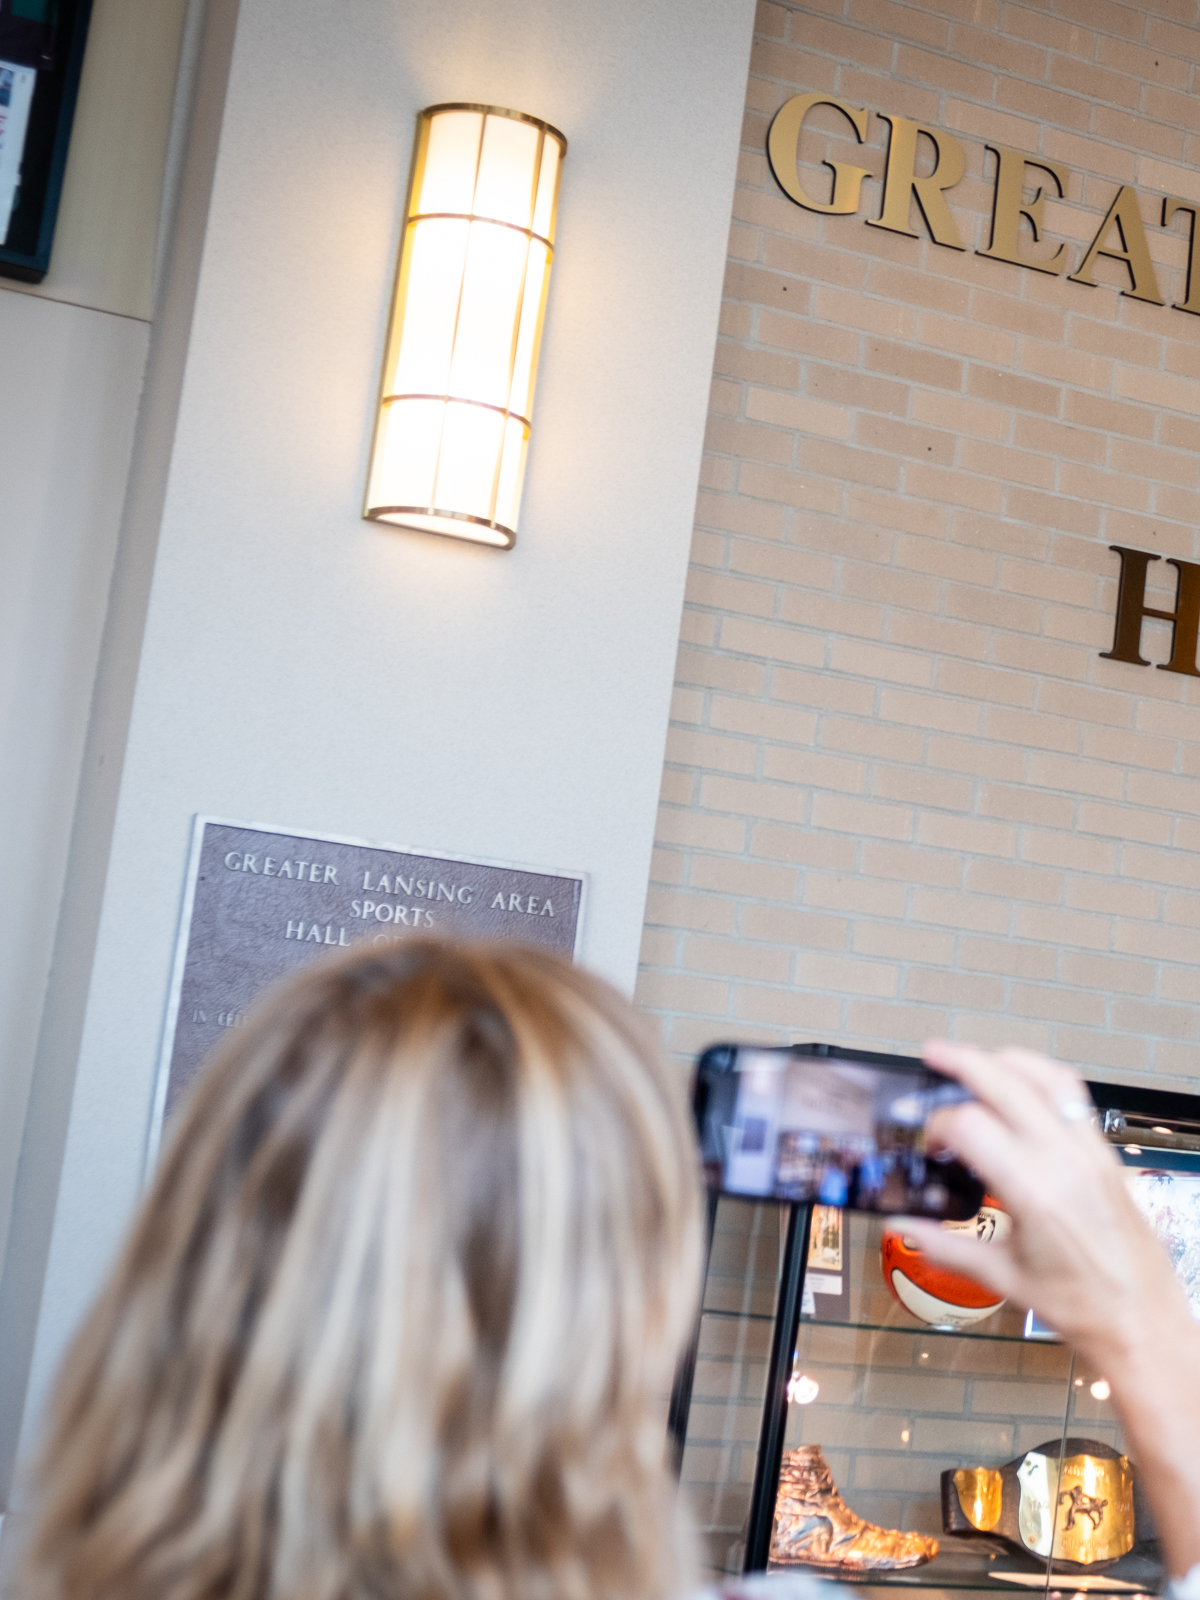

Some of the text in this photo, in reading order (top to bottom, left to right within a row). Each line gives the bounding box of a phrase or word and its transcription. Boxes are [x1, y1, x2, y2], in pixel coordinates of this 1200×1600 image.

[224, 851, 555, 918] GREATER LANSING AREA
[350, 899, 434, 929] SPORTS
[285, 920, 351, 947] HALL
